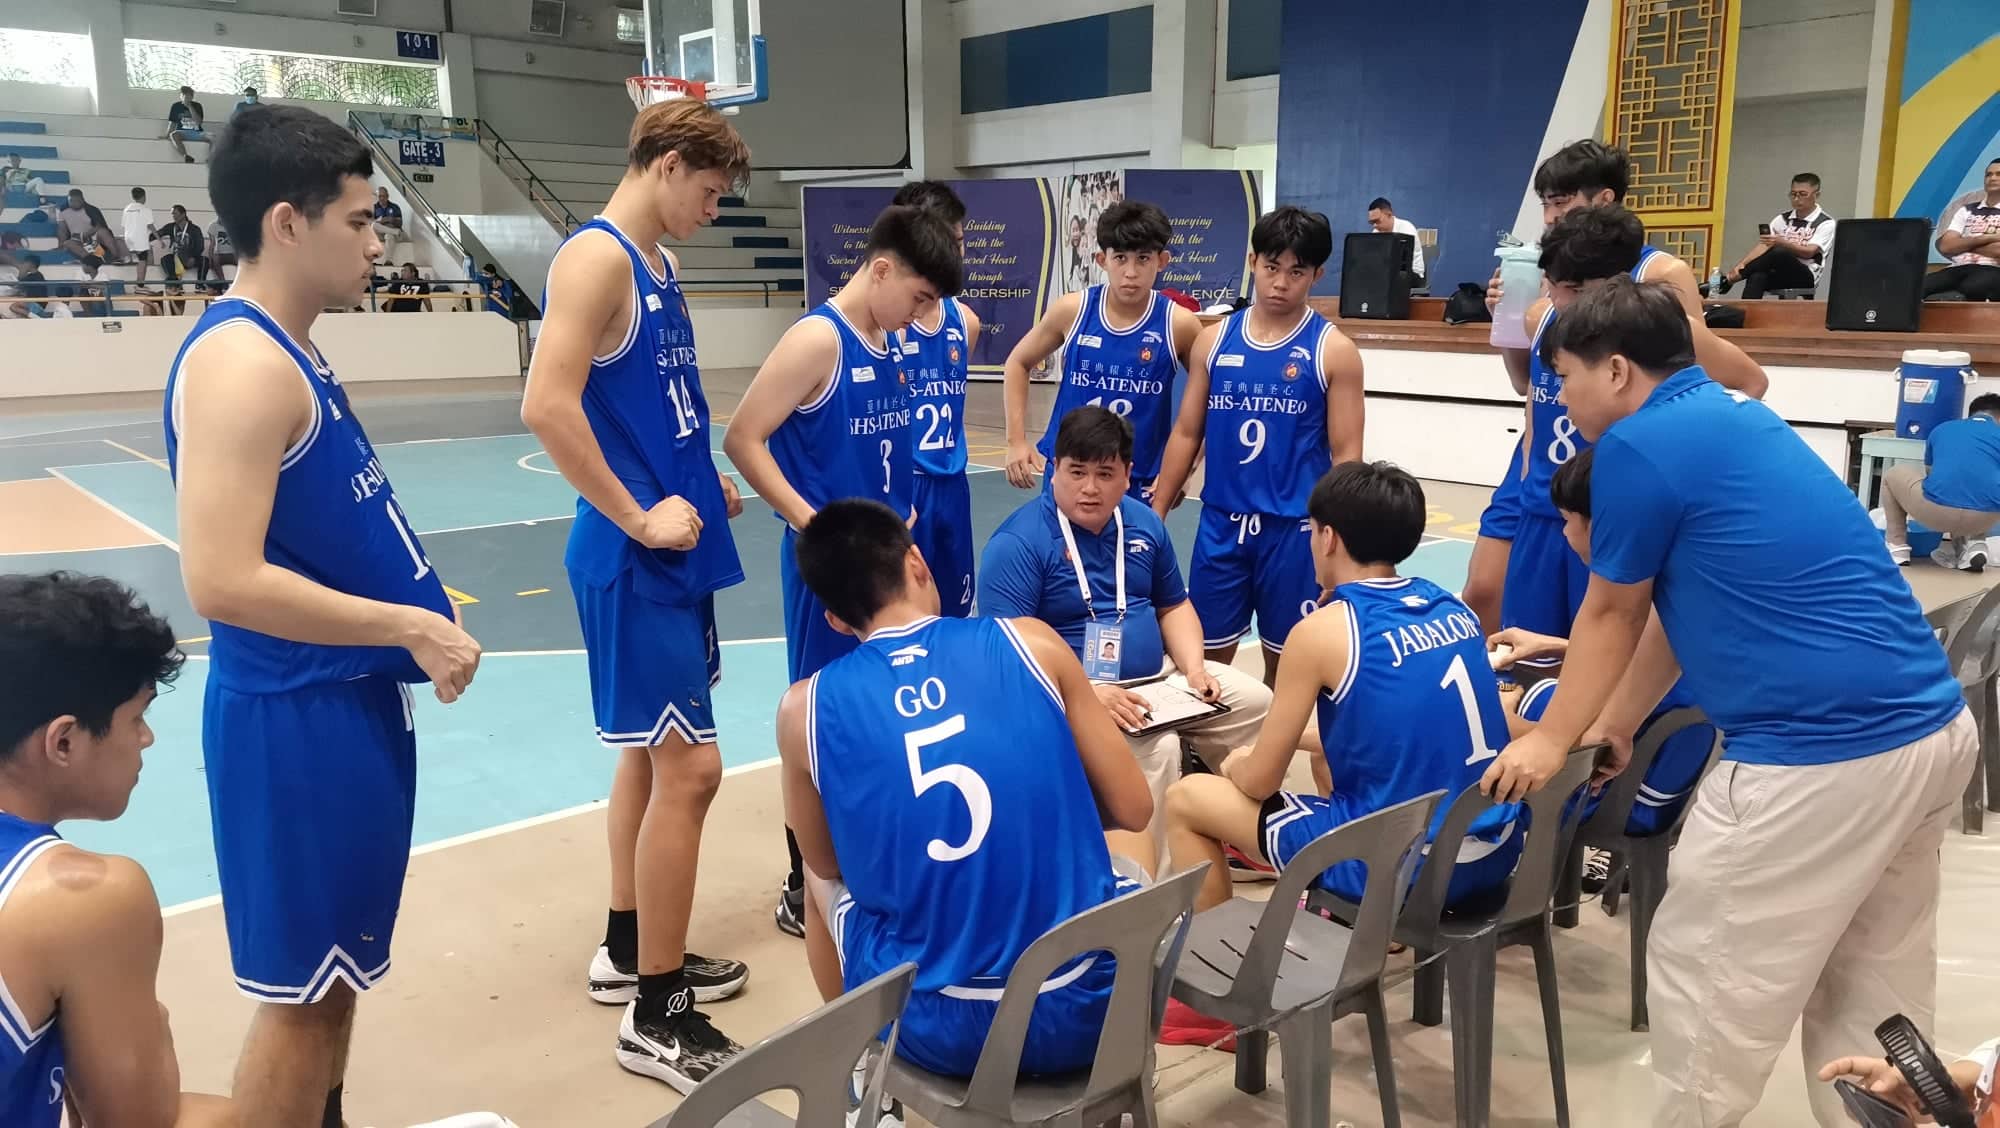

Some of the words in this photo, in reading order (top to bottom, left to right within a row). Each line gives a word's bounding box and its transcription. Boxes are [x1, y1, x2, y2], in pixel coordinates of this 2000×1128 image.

[404, 33, 431, 48] 101
[403, 141, 428, 156] GATE
[434, 142, 441, 157] 3
[964, 219, 1006, 234] Building
[967, 237, 987, 248] with
[991, 237, 1005, 248] the
[1168, 233, 1185, 245] ith
[1188, 233, 1205, 245] the
[827, 253, 859, 264] Sacred
[963, 254, 988, 264] acred
[989, 253, 1017, 264] Heart
[1188, 251, 1218, 264] Heart
[968, 271, 1003, 285] through
[1163, 270, 1202, 284] through
[956, 288, 1031, 298] ADERSHIP
[1070, 371, 1163, 395] HS-ATENEO
[915, 402, 955, 451] 22
[1239, 418, 1266, 465] 9
[1548, 415, 1577, 465] 8
[880, 438, 893, 494] 3
[1382, 611, 1480, 668] JABALON
[894, 676, 947, 718] GO
[1440, 653, 1498, 767] 1
[904, 713, 993, 862] 5
